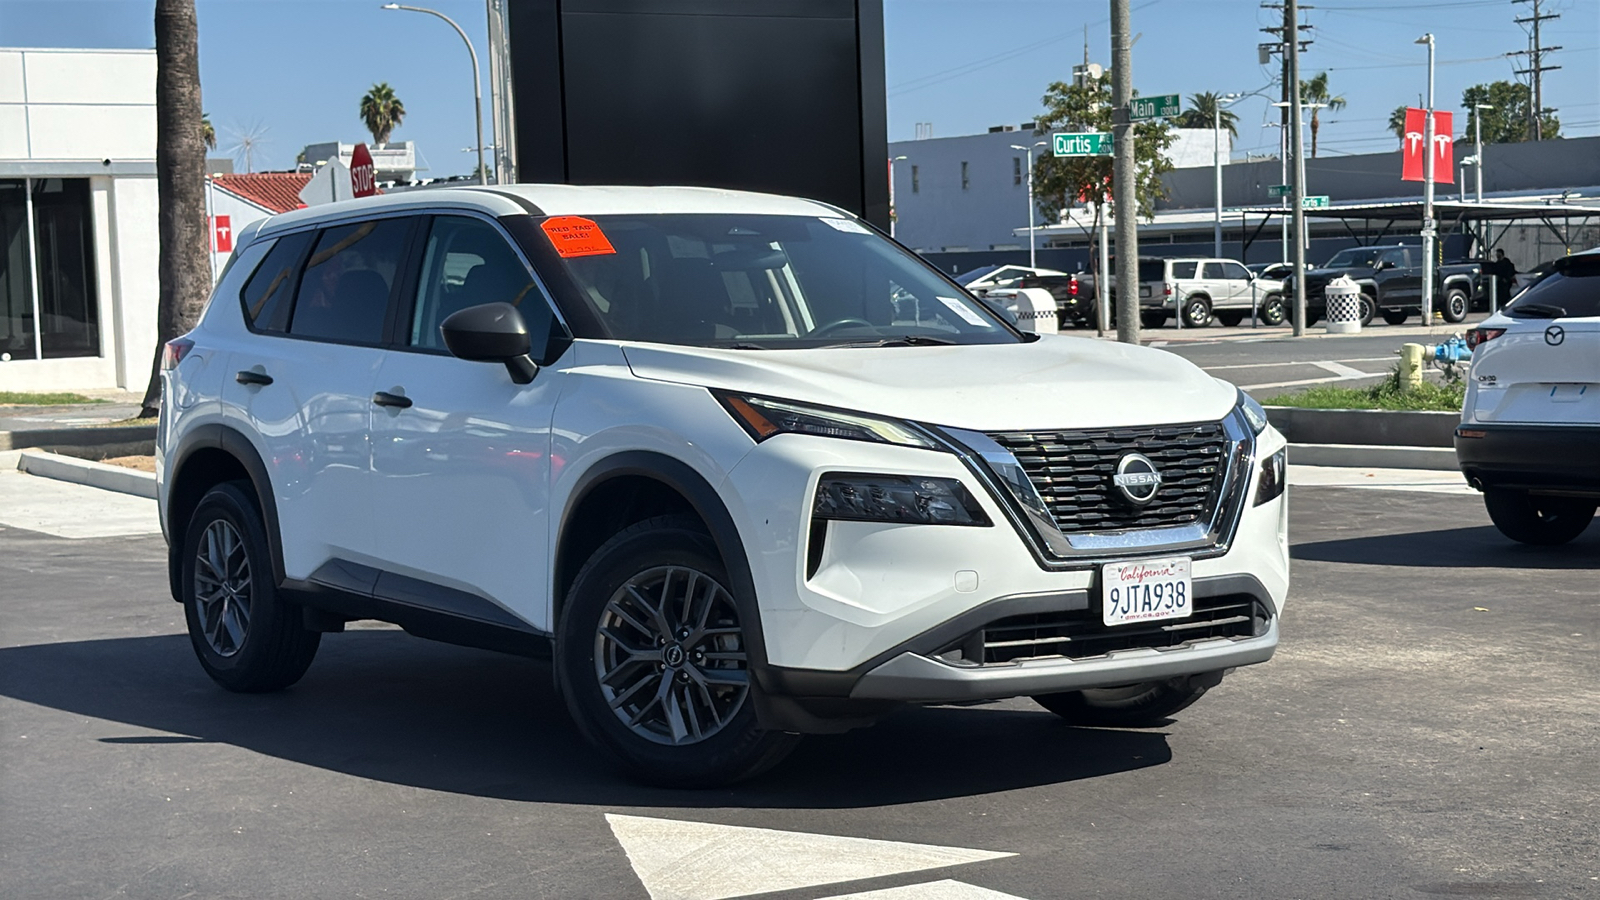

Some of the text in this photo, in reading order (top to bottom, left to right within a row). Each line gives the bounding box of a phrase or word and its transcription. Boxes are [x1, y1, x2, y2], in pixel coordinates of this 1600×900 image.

[1131, 100, 1155, 117] Main
[1056, 136, 1091, 153] Curtis
[352, 164, 374, 193] STOP
[1115, 474, 1162, 486] NISSAN
[1120, 565, 1175, 583] California
[1110, 581, 1186, 616] 9JTA938
[1125, 610, 1170, 620] dmv.ca.gov
